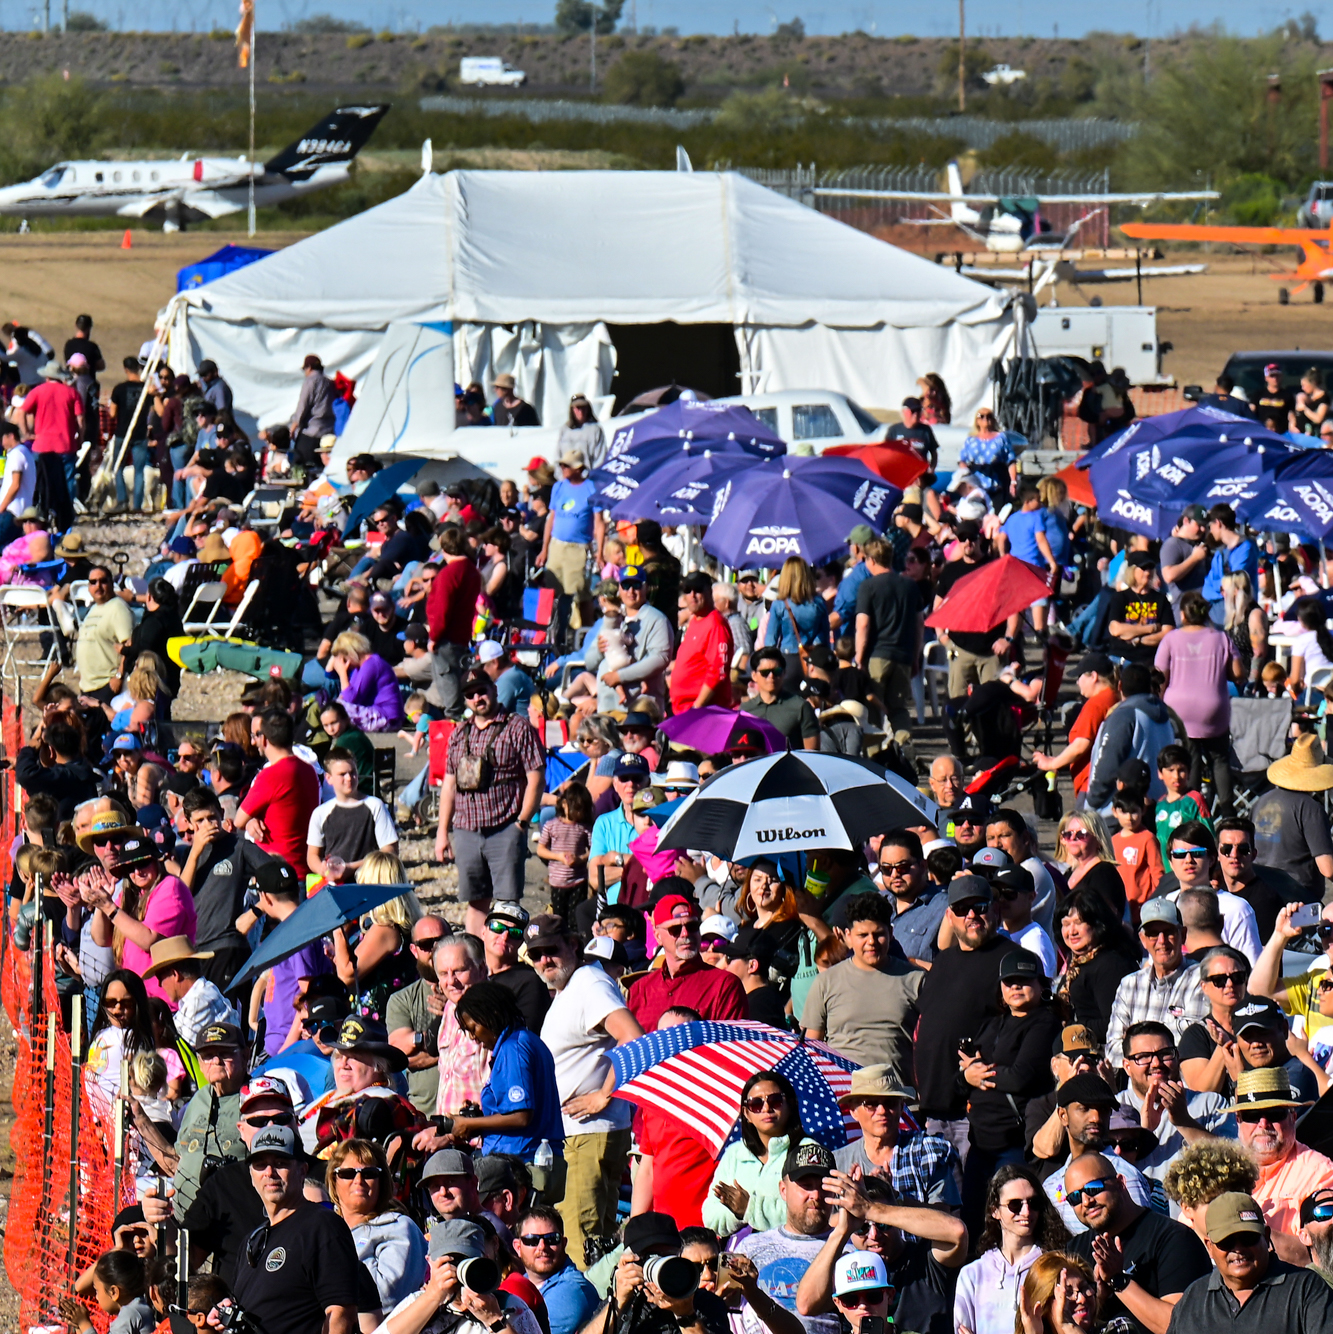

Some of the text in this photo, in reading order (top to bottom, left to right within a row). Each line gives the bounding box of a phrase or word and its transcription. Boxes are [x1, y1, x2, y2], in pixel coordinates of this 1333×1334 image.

[862, 485, 890, 521] AOPA
[1111, 498, 1152, 526] AOPA
[746, 537, 801, 555] AOPA
[959, 796, 972, 809] A
[756, 827, 827, 843] Wilson
